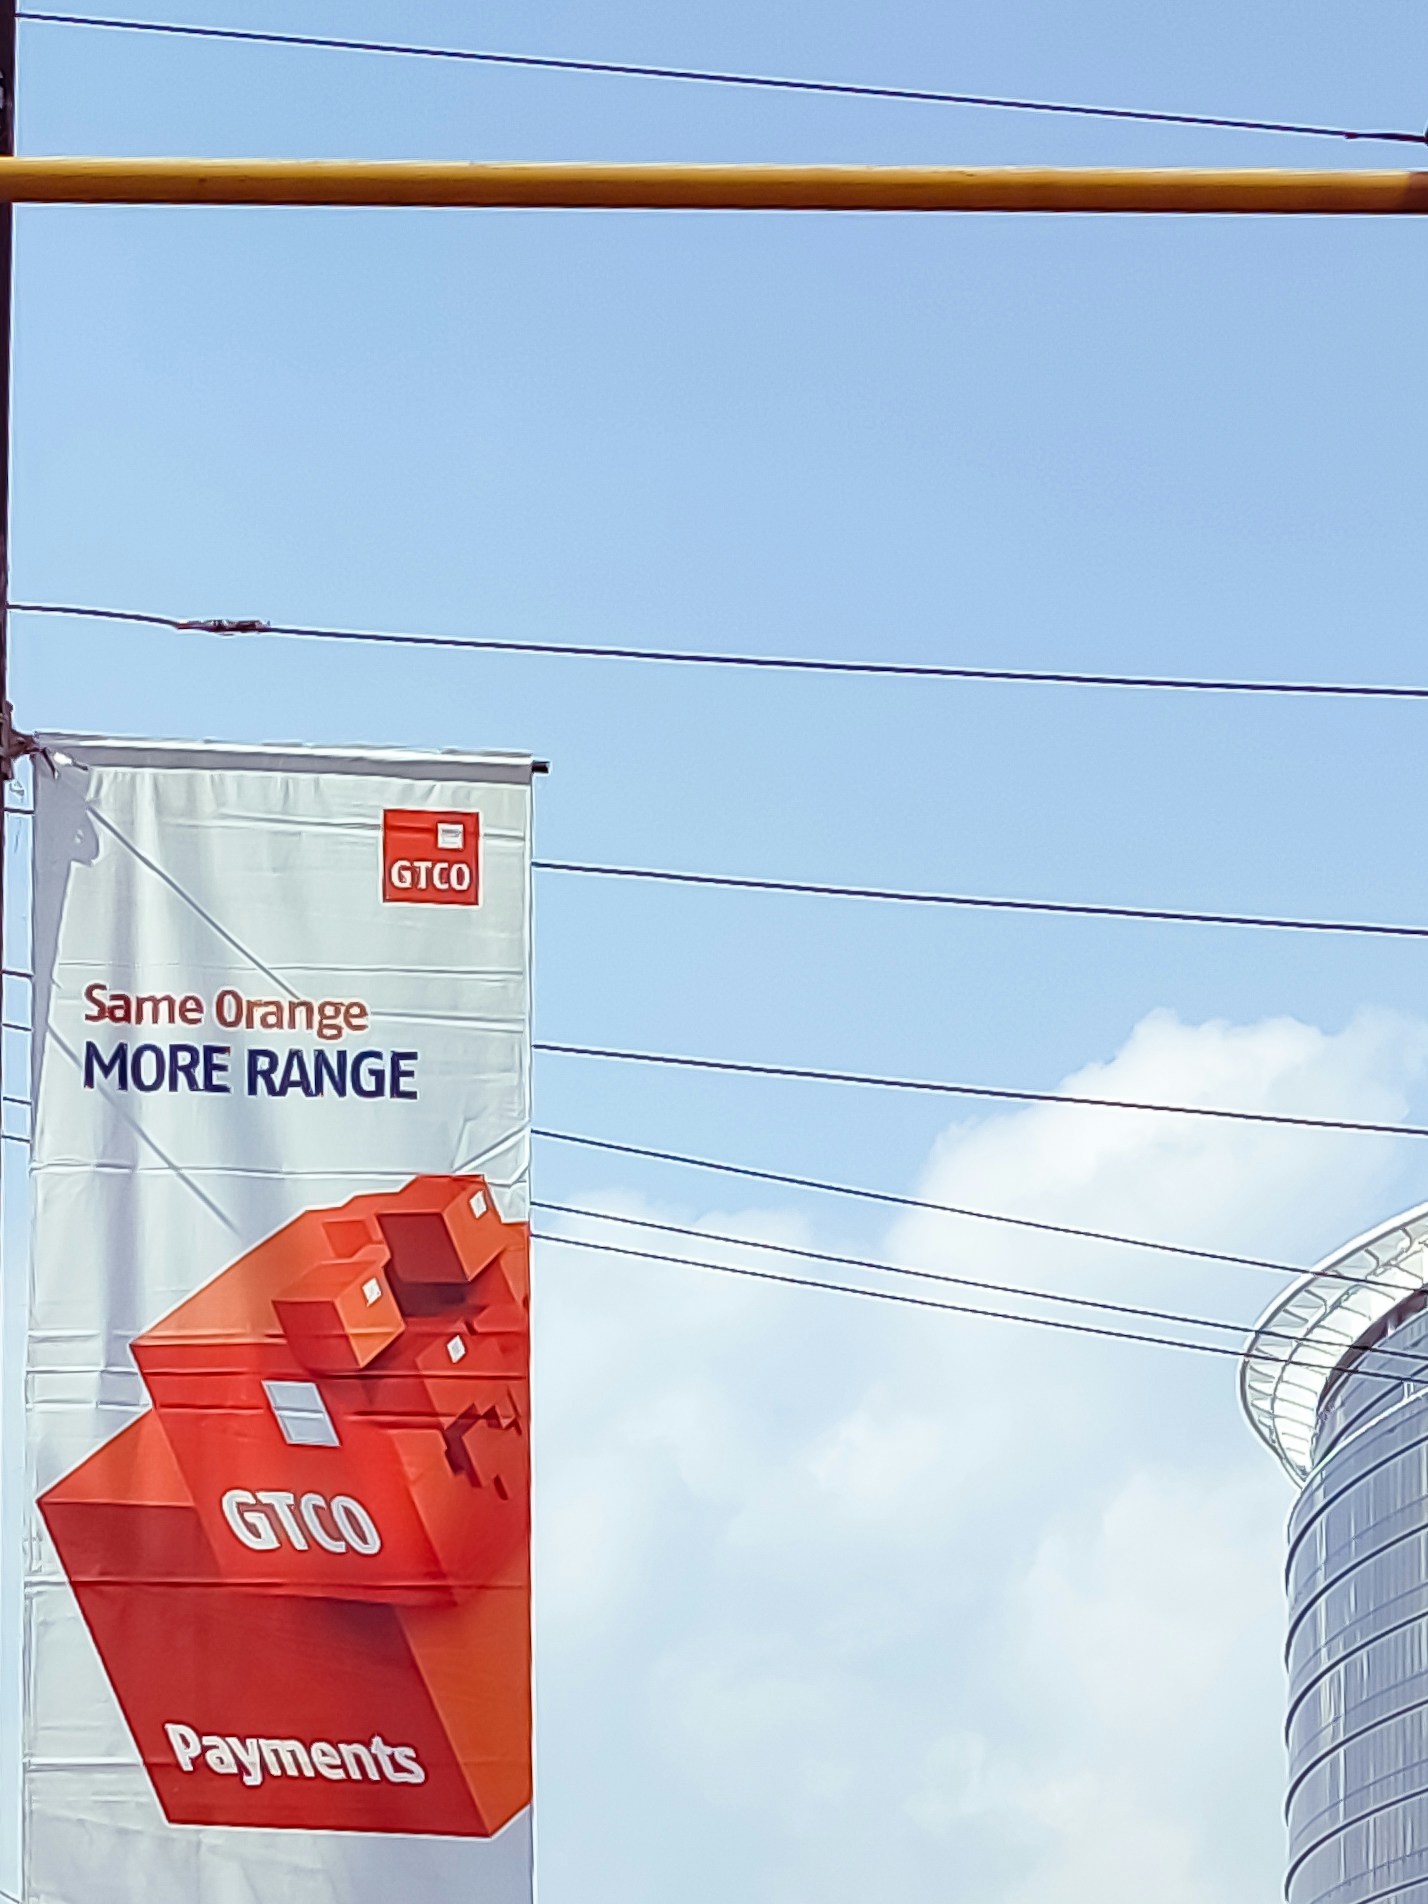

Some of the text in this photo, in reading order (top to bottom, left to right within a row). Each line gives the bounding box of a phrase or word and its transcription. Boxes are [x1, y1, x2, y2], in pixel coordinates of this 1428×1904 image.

[390, 859, 471, 891] GTCO
[84, 983, 369, 1040] Same Orange
[83, 1040, 419, 1099] MORE RANGE
[221, 1488, 382, 1555] GTCO
[164, 1722, 426, 1786] Payments
